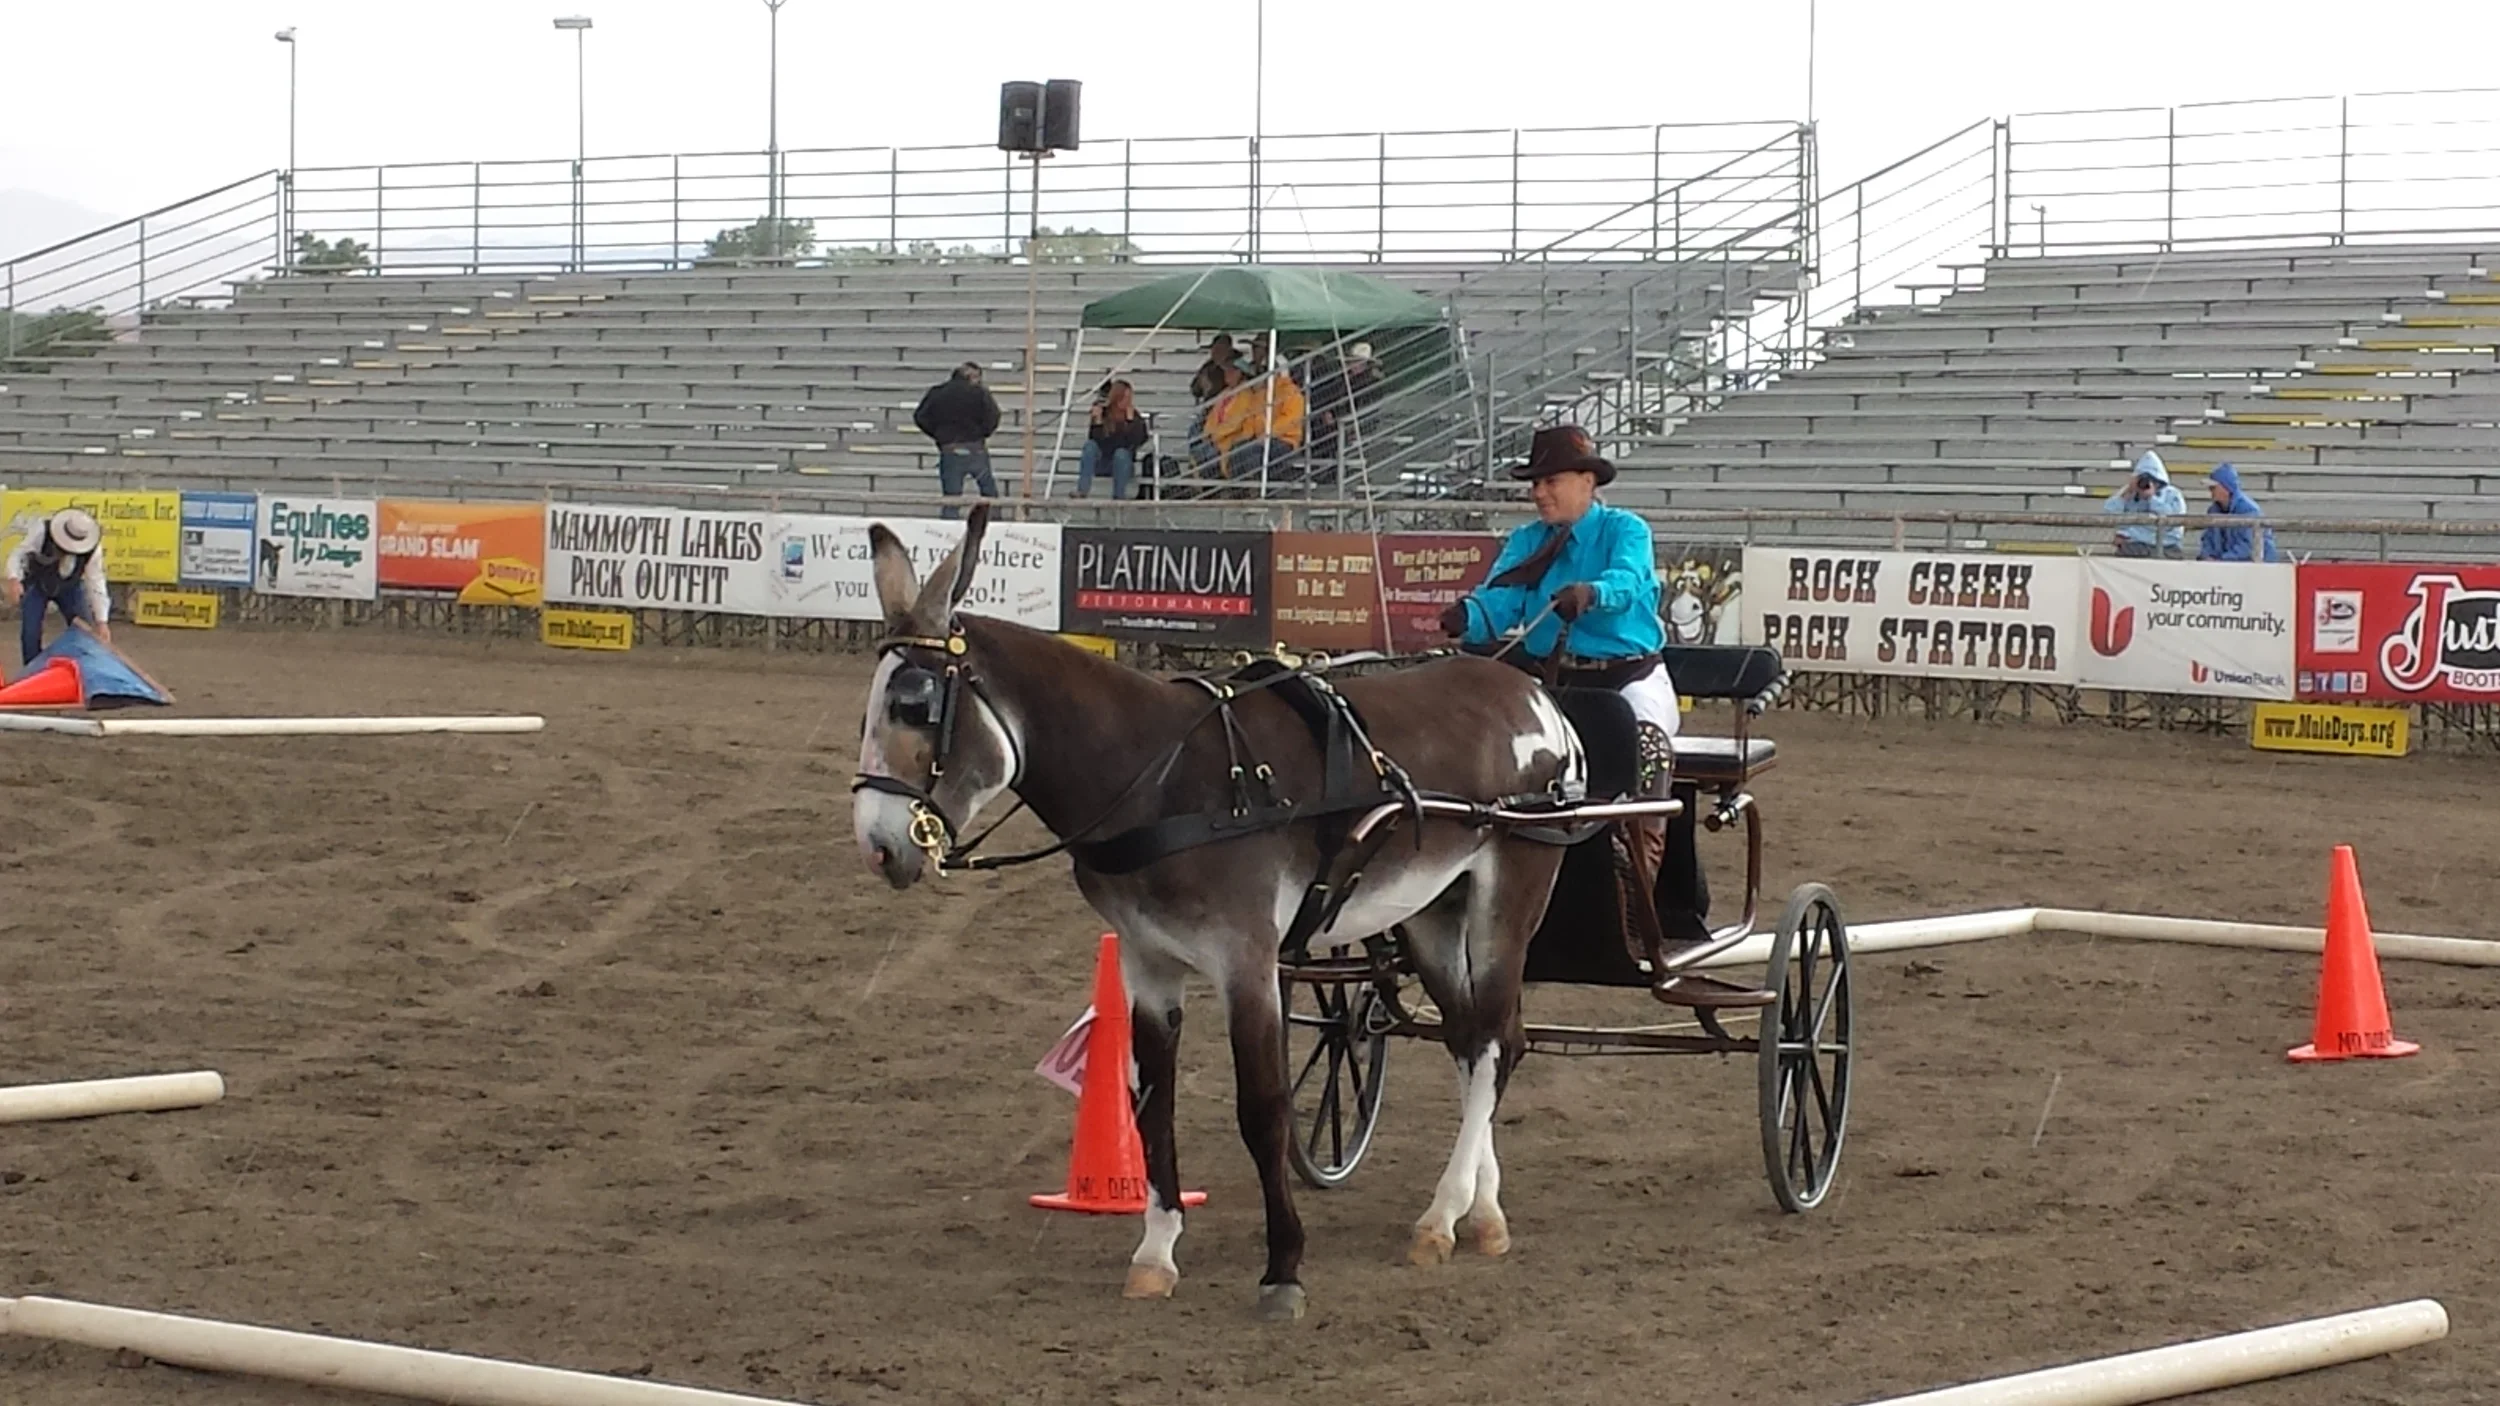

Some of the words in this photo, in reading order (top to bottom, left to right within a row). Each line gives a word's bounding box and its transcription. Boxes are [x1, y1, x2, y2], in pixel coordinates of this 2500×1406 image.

[271, 502, 370, 564] Equines
[379, 535, 428, 557] GRAND
[431, 538, 480, 560] SLAM
[551, 510, 670, 556] MAMMOTH
[681, 517, 763, 561] LAKES
[812, 534, 840, 560] We
[571, 556, 626, 597] PACK
[635, 559, 728, 604] OUTFIT
[1079, 543, 1252, 595] PLATINUM
[1788, 557, 1882, 603] ROCK
[1908, 561, 2033, 610] CREEK
[835, 581, 869, 602] you
[1080, 594, 1246, 613] PERFORMANCE
[2150, 583, 2244, 612] Supporting
[2147, 612, 2185, 631] your
[2186, 612, 2286, 637] community.
[1764, 614, 1850, 661] PACK
[1877, 617, 2058, 671] STATION
[2452, 670, 2500, 687] BOOT
[2264, 713, 2396, 749] www.MuleDays.org
